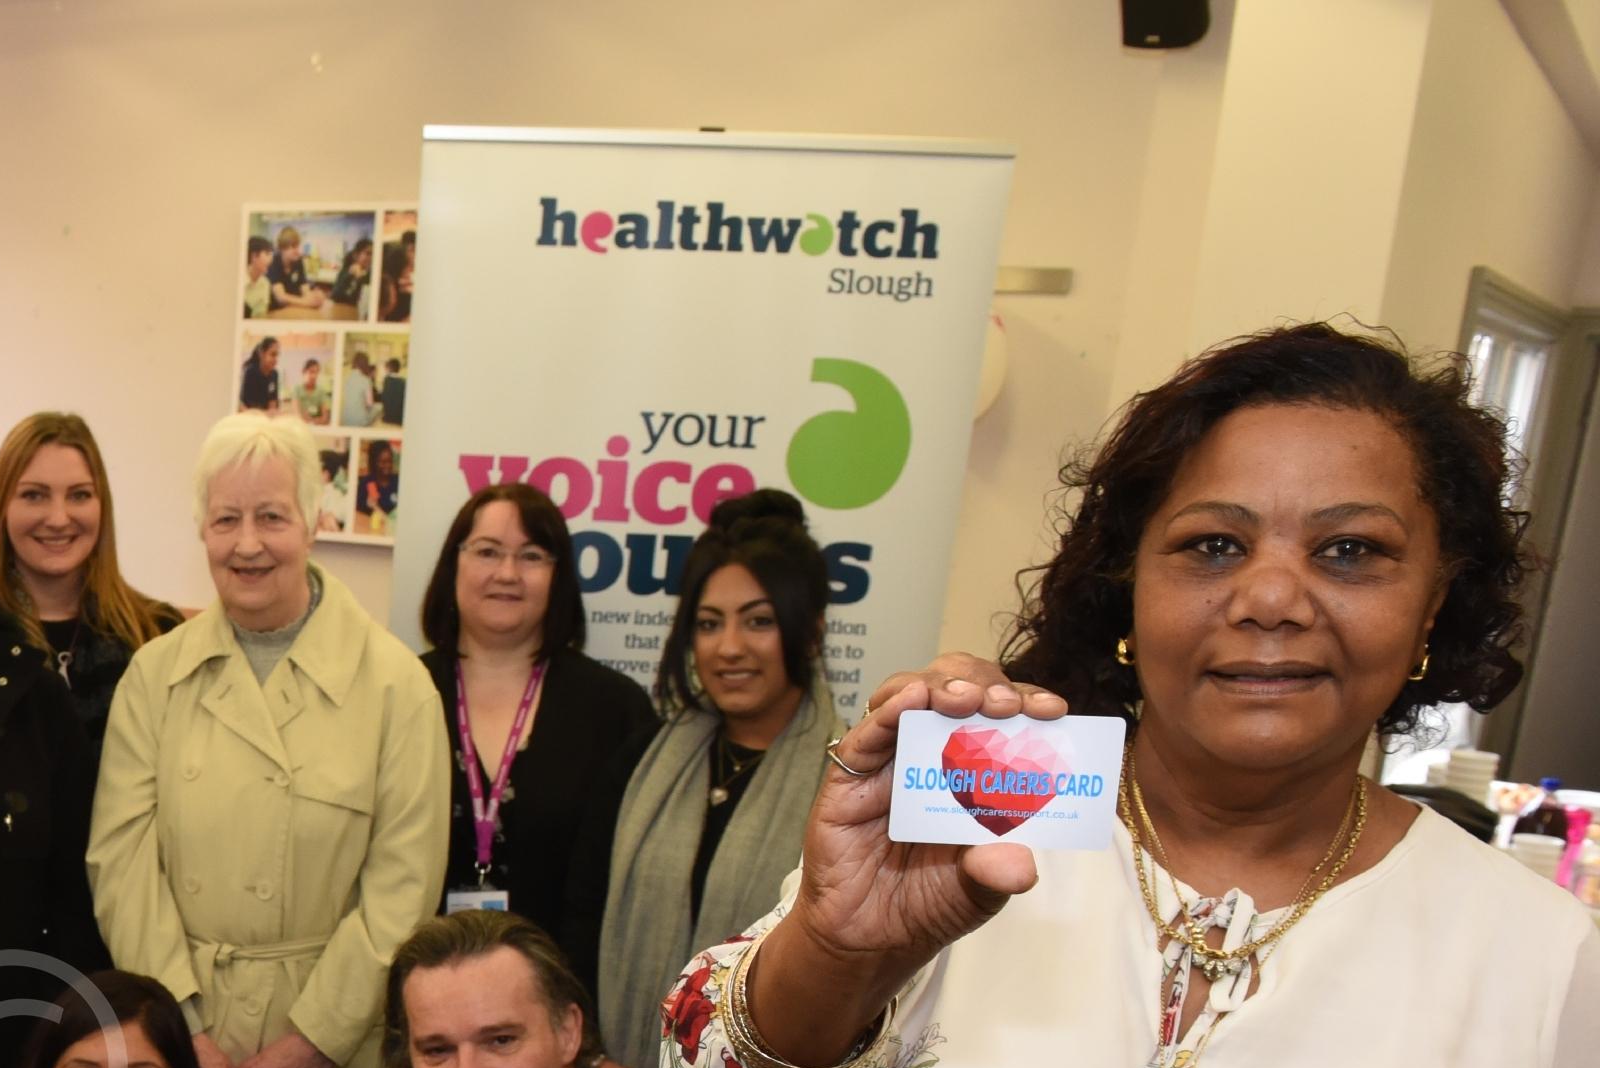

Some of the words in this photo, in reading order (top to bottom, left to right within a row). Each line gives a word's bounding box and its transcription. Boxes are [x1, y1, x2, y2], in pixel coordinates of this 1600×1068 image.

[536, 197, 940, 259] healthwatch
[827, 268, 934, 302] Slough
[639, 411, 766, 455] your
[458, 435, 757, 525] voice
[591, 610, 630, 624] new
[625, 634, 659, 650] that
[845, 645, 865, 659] to
[838, 692, 858, 707] of
[904, 767, 976, 793] SLOUGH
[981, 770, 1050, 796] CARERS
[1055, 774, 1104, 798] CARD
[924, 806, 1079, 820] www.sloughcarerssupport.co.uk
